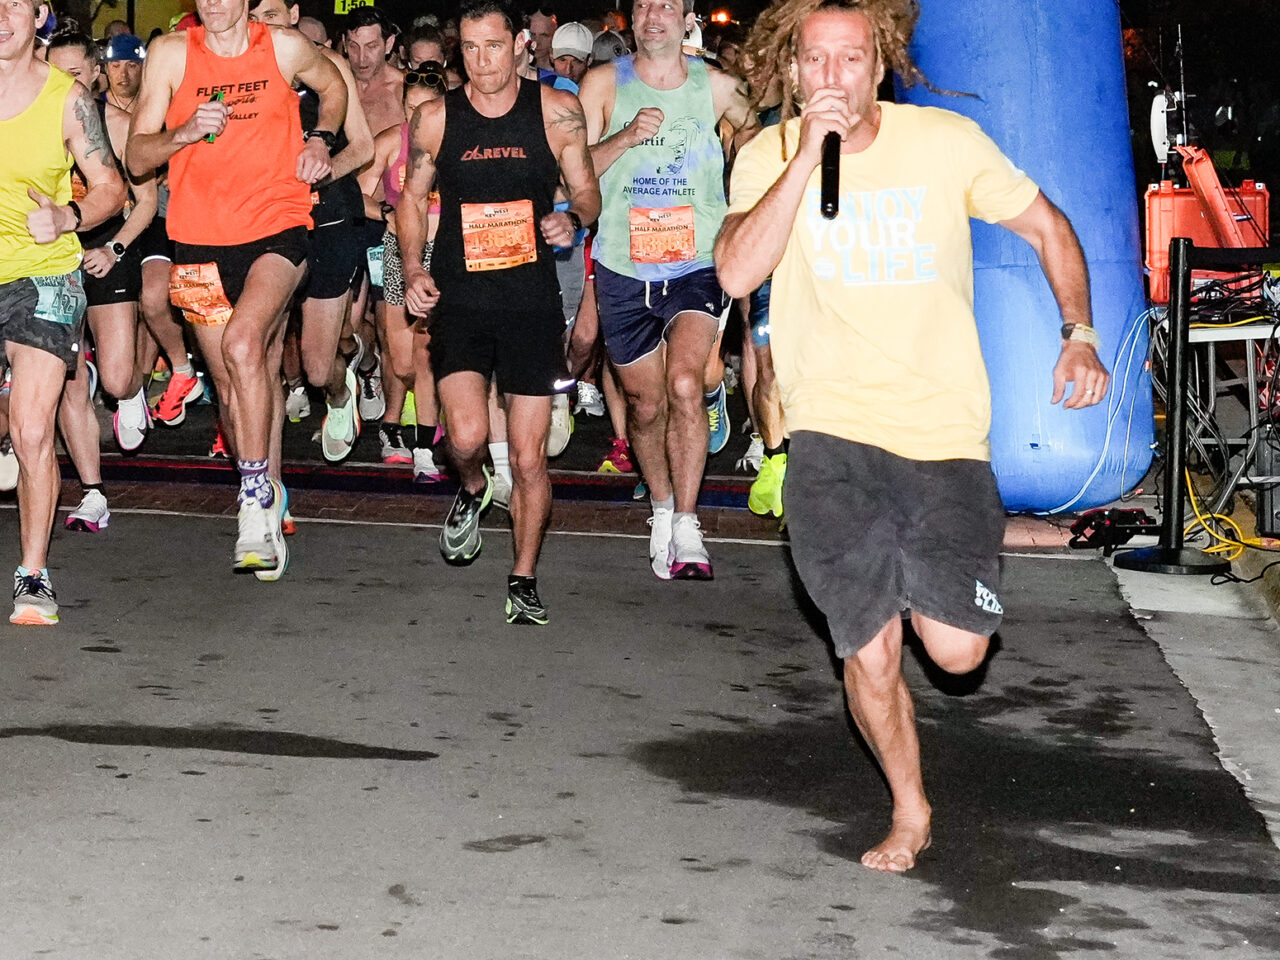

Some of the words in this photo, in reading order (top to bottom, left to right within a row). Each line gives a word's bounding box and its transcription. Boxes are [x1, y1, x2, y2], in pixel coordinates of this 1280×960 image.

[197, 84, 235, 97] FLEET
[238, 80, 269, 93] FEET
[483, 146, 527, 159] REVEL
[633, 177, 657, 185] HOME
[659, 177, 670, 185] OF
[673, 178, 687, 186] THE
[623, 186, 660, 195] AVERAGE
[662, 188, 695, 196] ATHLETE
[806, 186, 927, 223] ENJOY
[487, 219, 527, 228] MARATHON
[652, 224, 688, 232] MARATHON
[807, 218, 916, 253] YOUR
[842, 243, 937, 280] LIFE
[51, 292, 78, 315] 427
